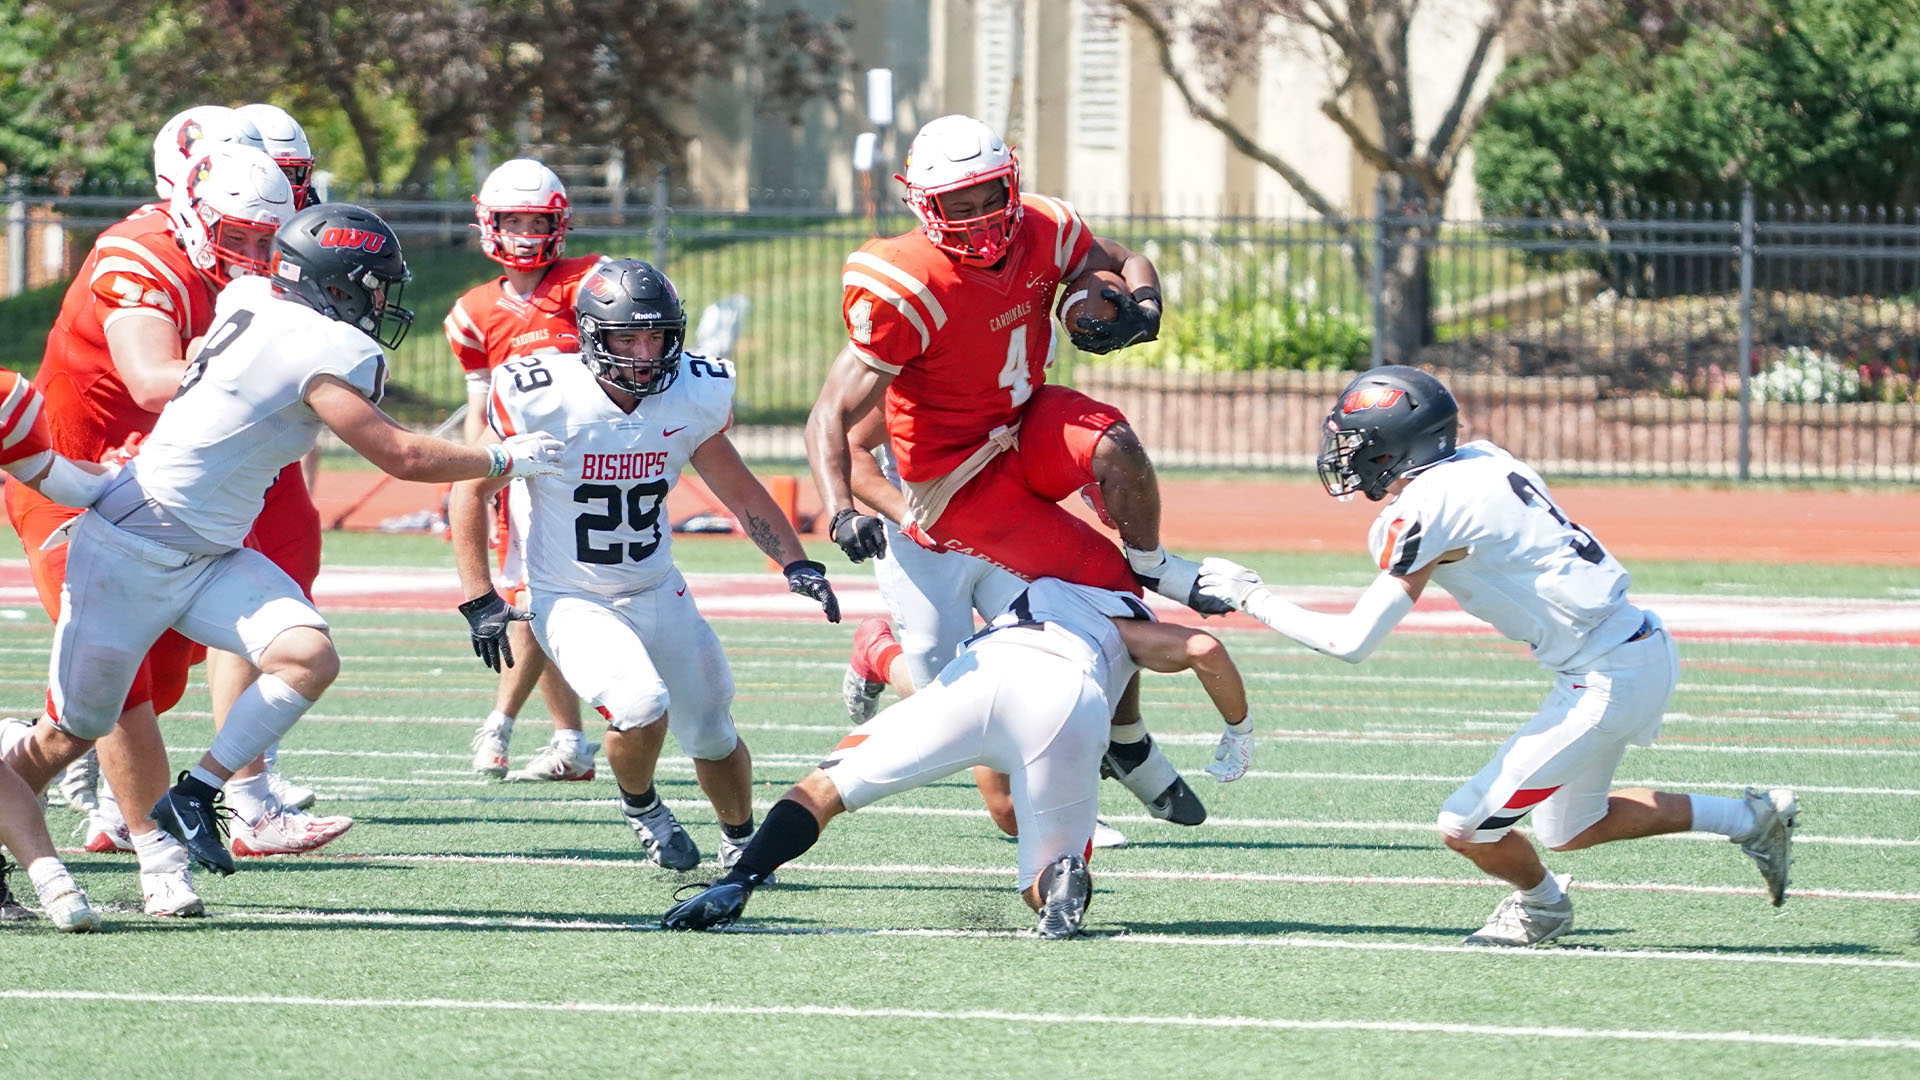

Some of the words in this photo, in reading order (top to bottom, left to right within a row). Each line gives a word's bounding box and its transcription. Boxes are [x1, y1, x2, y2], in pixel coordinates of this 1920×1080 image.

[319, 228, 386, 253] OWU
[848, 298, 873, 346] 4
[990, 301, 1031, 332] CARDINALS
[512, 328, 550, 347] CARDINALS
[503, 357, 553, 393] 29
[997, 323, 1033, 408] 4
[581, 451, 668, 480] BISHOPS
[573, 478, 669, 565] 29
[1506, 471, 1606, 565] 3
